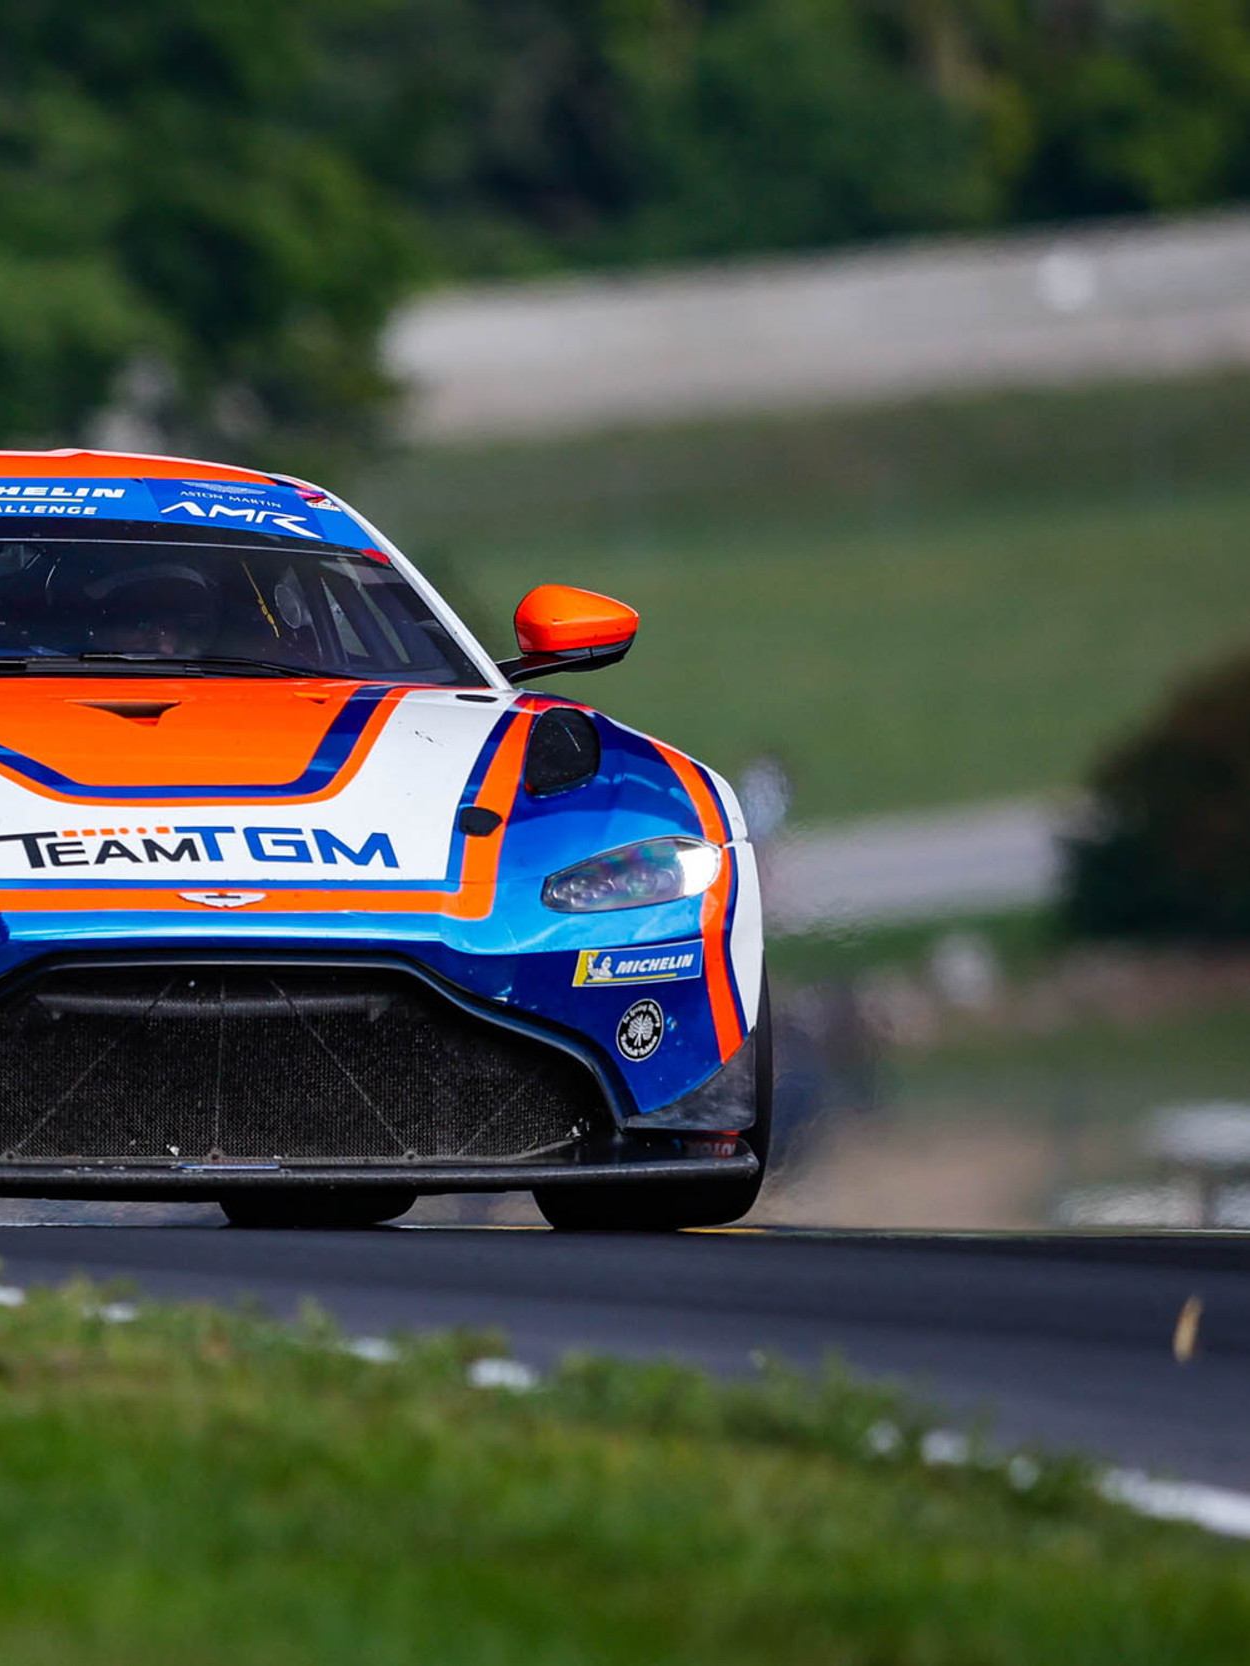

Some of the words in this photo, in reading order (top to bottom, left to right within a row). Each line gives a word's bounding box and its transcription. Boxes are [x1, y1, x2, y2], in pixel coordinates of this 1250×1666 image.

[180, 490, 225, 501] ASTON
[229, 496, 281, 509] MARTIN
[160, 501, 324, 539] AMR
[615, 953, 694, 975] MICHELIN
